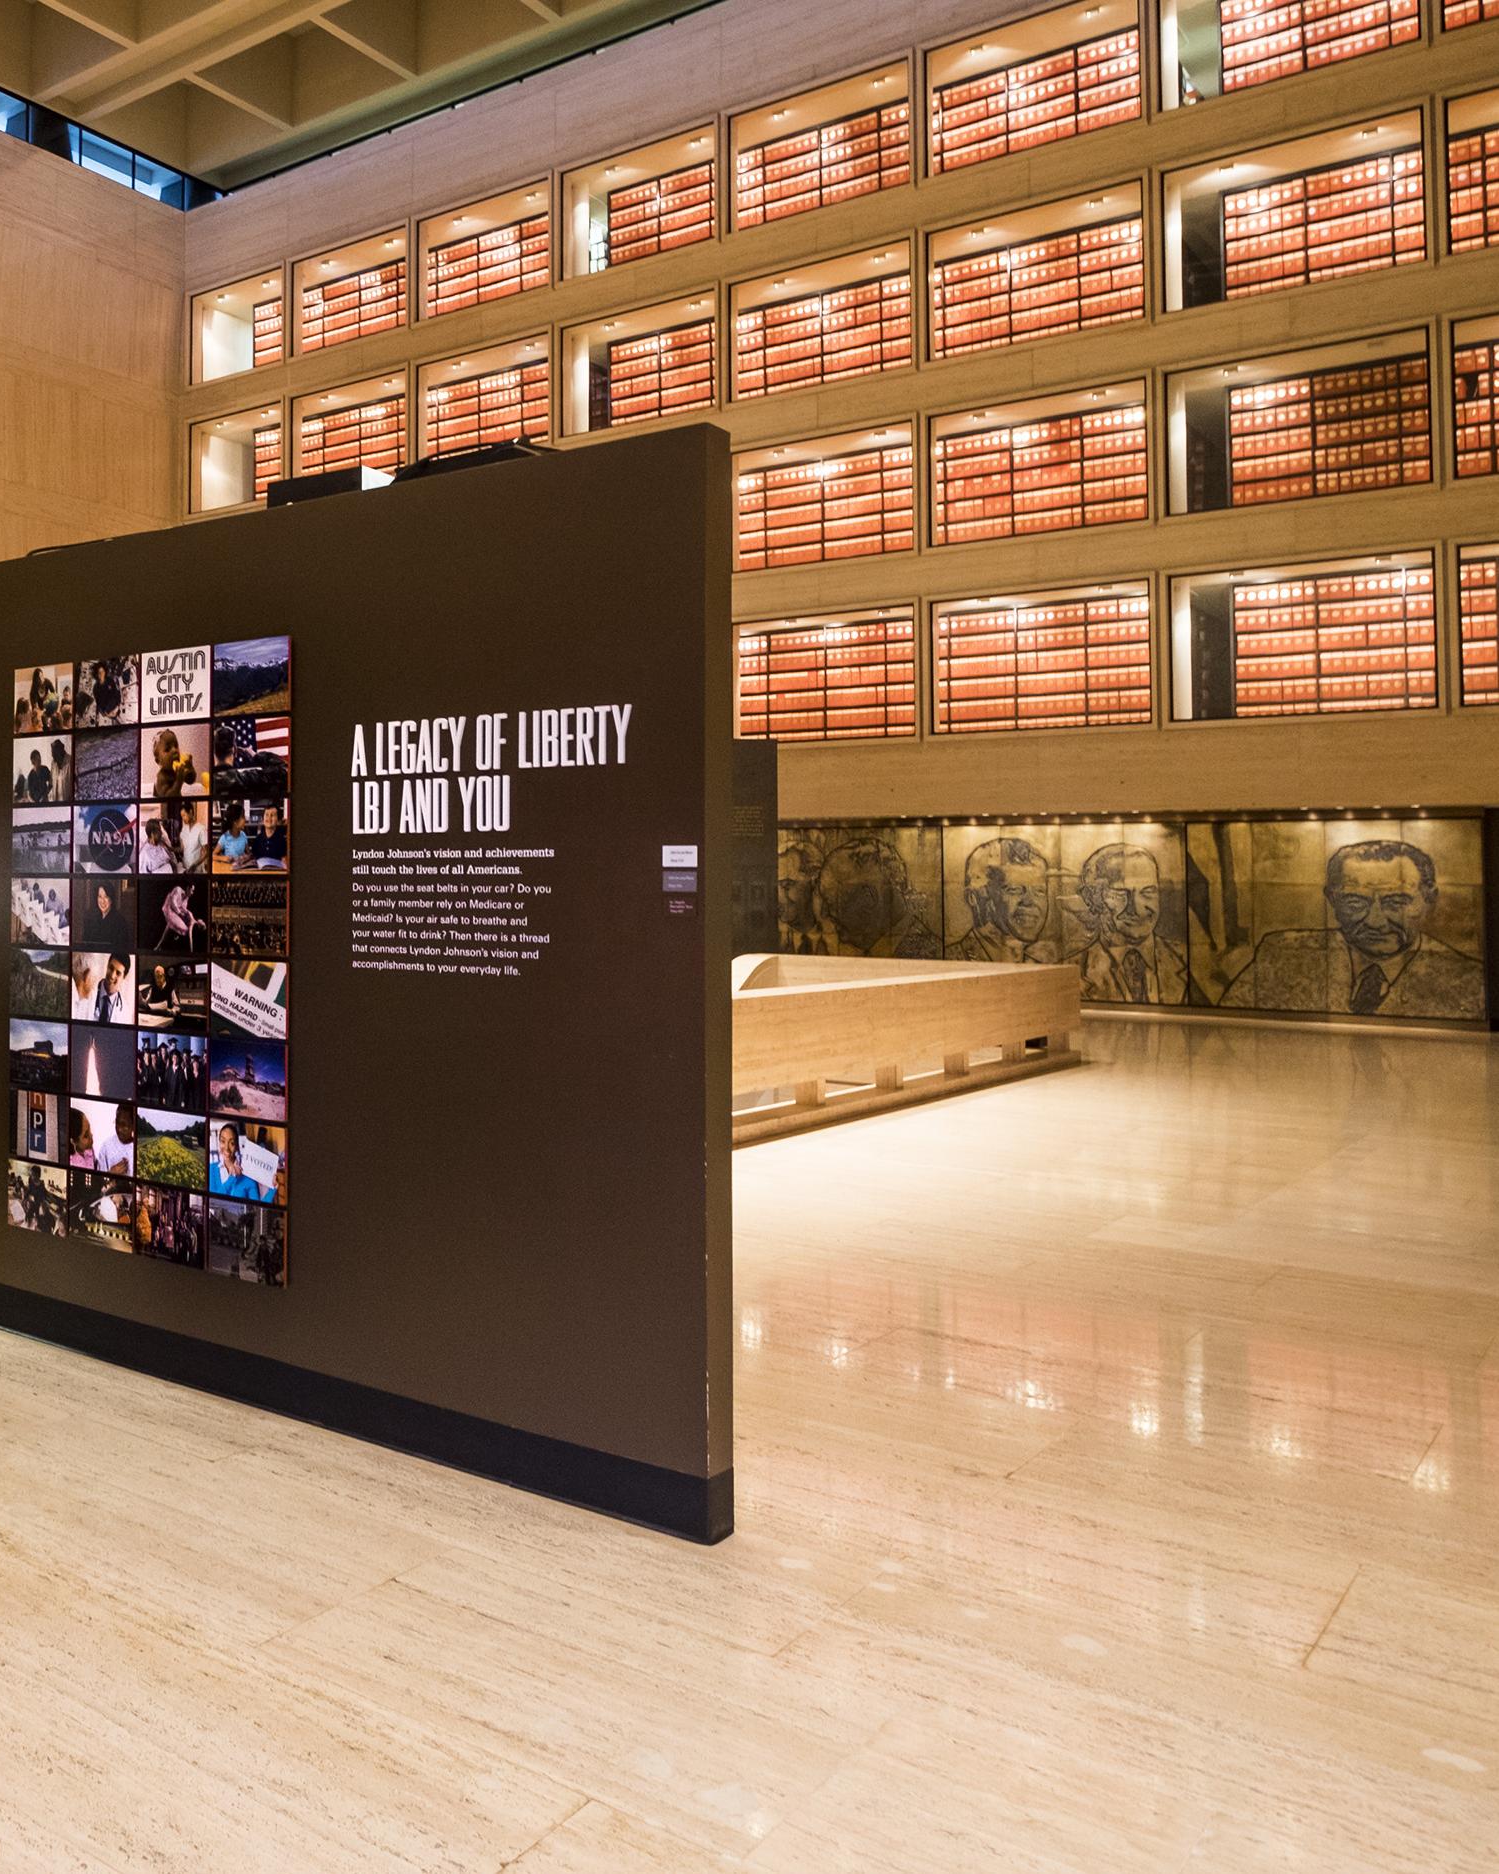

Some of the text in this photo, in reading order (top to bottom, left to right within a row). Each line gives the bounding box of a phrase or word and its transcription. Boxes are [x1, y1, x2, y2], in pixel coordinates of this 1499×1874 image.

[146, 650, 205, 676] AUSTIN
[156, 672, 194, 694] CITY
[351, 703, 632, 777] A LEGACY OF LIBERTY
[352, 774, 511, 834] LBJ AND YOU
[92, 831, 132, 845] NASA
[352, 847, 554, 860] Lyndon Johnson's vision and achievements
[352, 864, 522, 875] still touch the lives of all Americans.
[352, 882, 551, 895] Do you use the seat belts in your car? Do you
[352, 897, 524, 910] or a family member rely on Medicare or
[352, 912, 528, 926] Medicaid? Is your air safe to breathe and
[351, 928, 550, 943] your water fit to drink? Then there is a thread
[352, 943, 539, 959] that connects Lyndon Johnson's vision and
[352, 960, 521, 976] accomplishments to your everyday life.
[211, 991, 258, 1021] KING HAZARD
[234, 988, 278, 1018] WARNING
